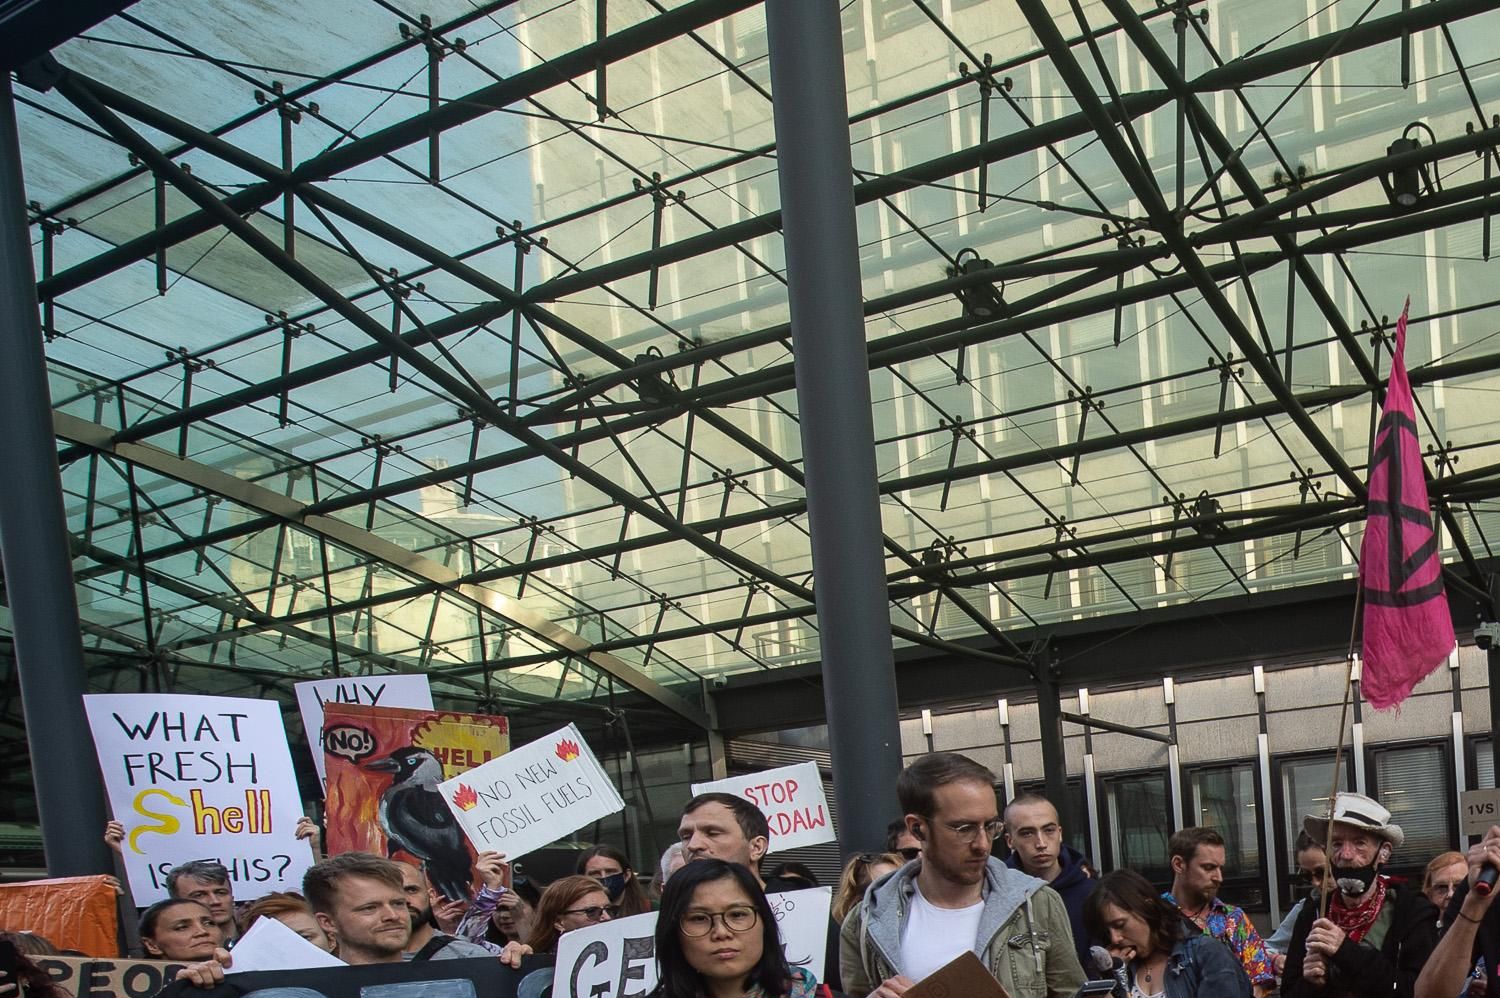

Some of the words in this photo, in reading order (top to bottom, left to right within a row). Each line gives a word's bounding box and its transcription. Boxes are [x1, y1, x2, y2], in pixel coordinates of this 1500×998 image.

[112, 711, 249, 743] WHAT
[329, 728, 371, 751] NO!
[123, 751, 258, 786] FRESH
[478, 780, 512, 808] NO
[515, 758, 558, 790] NEW
[744, 779, 799, 806] STOP
[477, 803, 542, 844] FOSSIL
[541, 777, 592, 814] FUELS
[1467, 803, 1494, 816] 1VS
